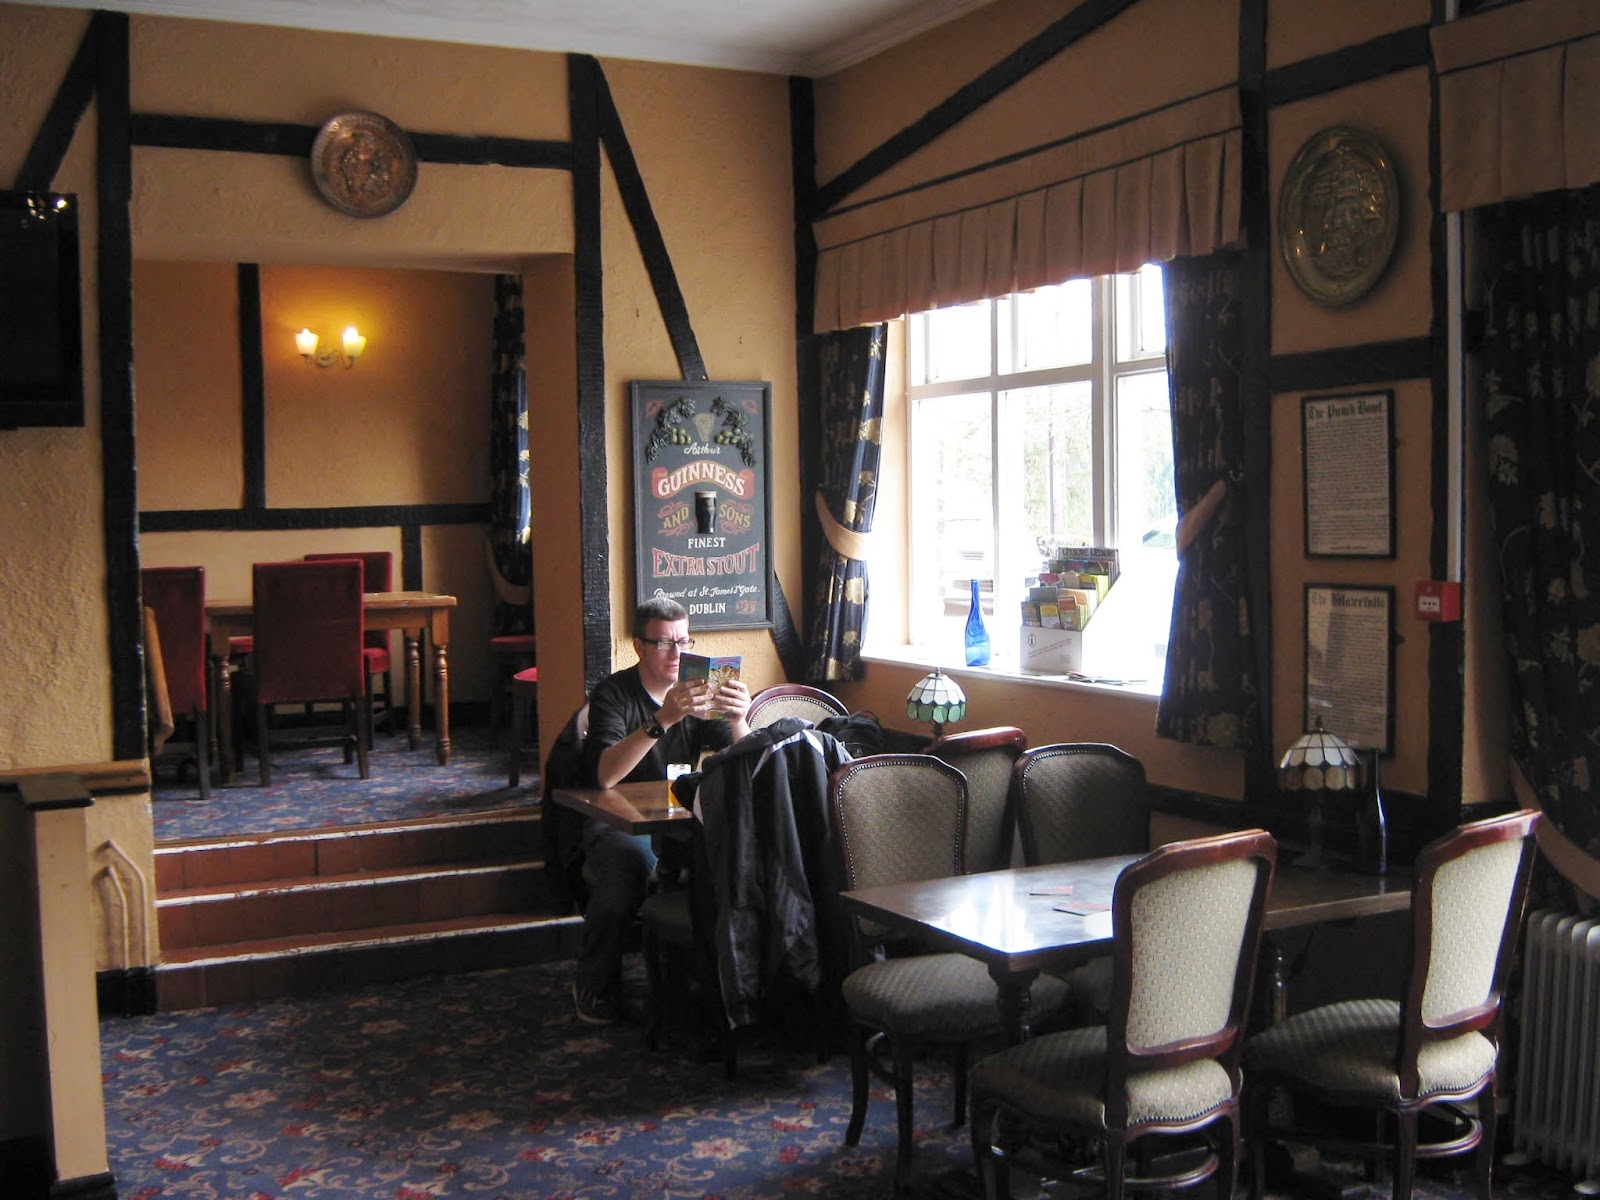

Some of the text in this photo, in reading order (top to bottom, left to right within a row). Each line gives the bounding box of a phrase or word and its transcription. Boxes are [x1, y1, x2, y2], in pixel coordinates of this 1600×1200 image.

[1308, 406, 1324, 419] The
[683, 442, 721, 455] Arthur
[657, 462, 746, 497] GUINNESS
[663, 503, 751, 528] AND SONS
[687, 537, 726, 549] FINEST
[652, 543, 760, 577] EXTRA STOUT
[653, 587, 687, 599] Brewed
[688, 588, 698, 598] at
[689, 602, 726, 615] DUBLIN
